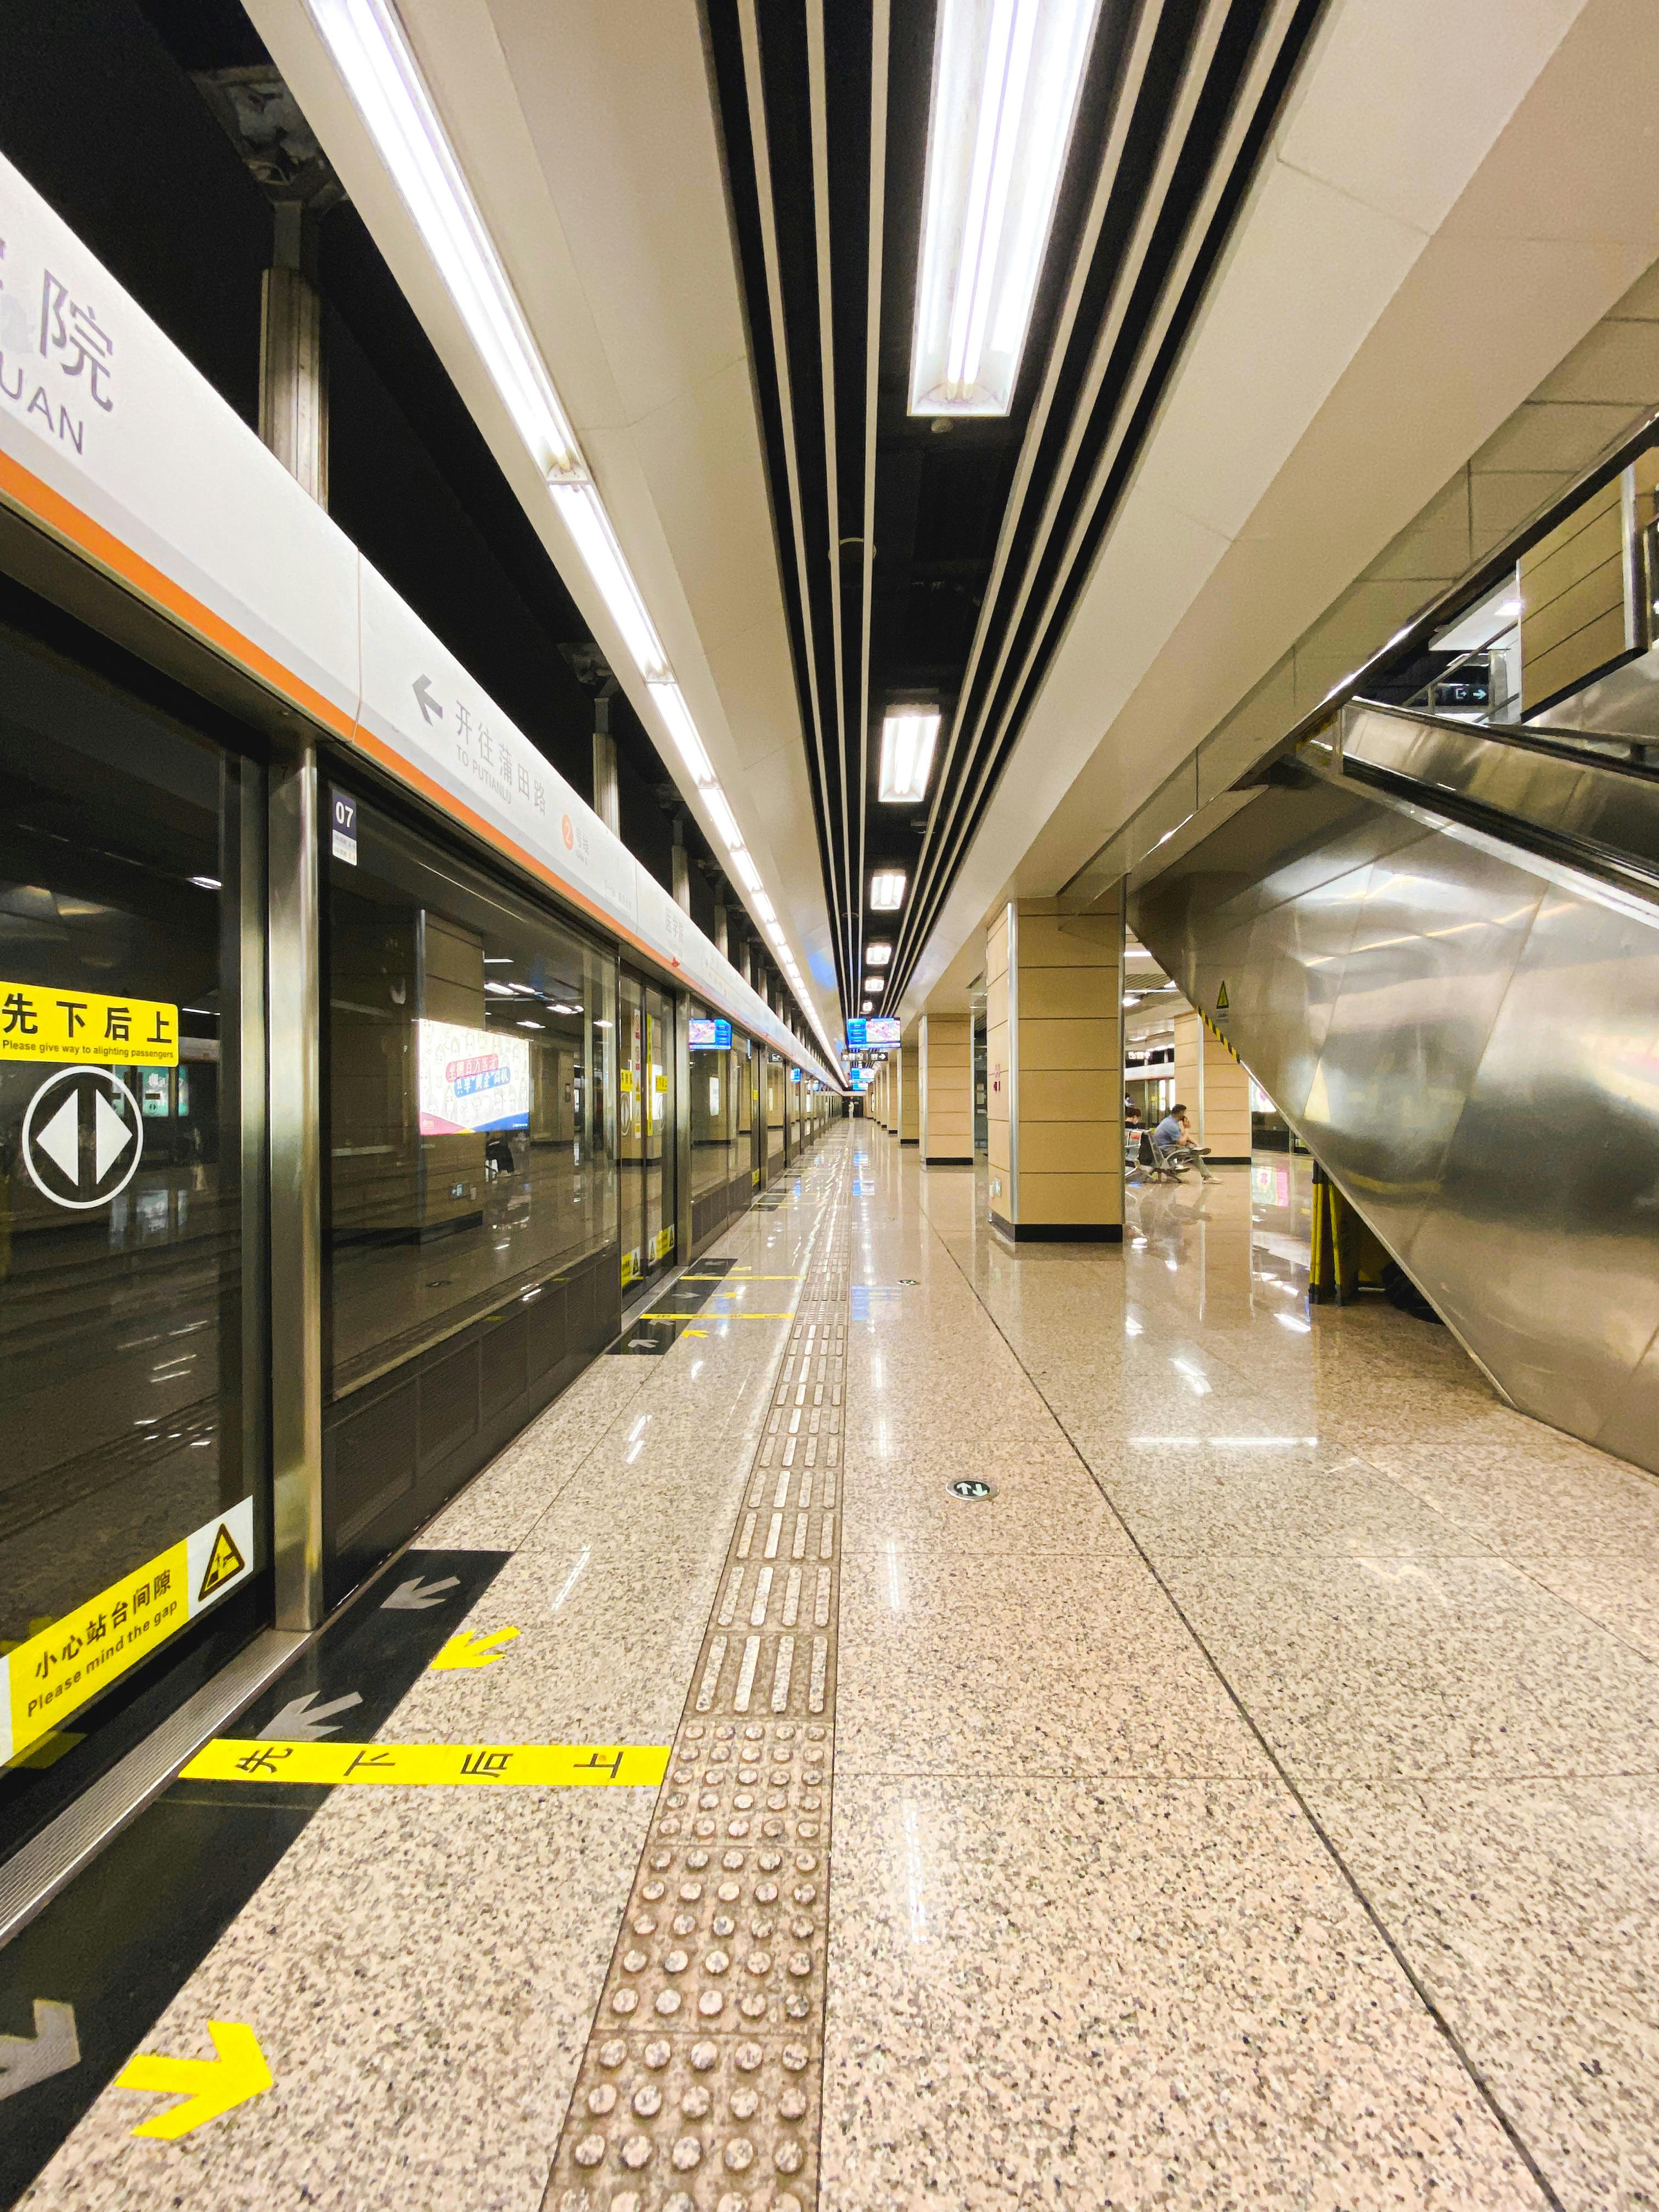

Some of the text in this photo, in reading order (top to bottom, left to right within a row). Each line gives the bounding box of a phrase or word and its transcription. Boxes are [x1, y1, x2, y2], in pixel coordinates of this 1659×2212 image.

[455, 699, 546, 816] 开往蒲田路
[456, 744, 512, 805] TO PUTIANLU
[335, 801, 354, 828] 07
[2, 993, 172, 1043] 先下后上
[3, 1040, 174, 1059] Please give way to alighting passengers
[35, 1569, 171, 1678] 小心站台间隙
[28, 1600, 177, 1718] Please mind the gap
[235, 1747, 624, 1779] 先下后上
